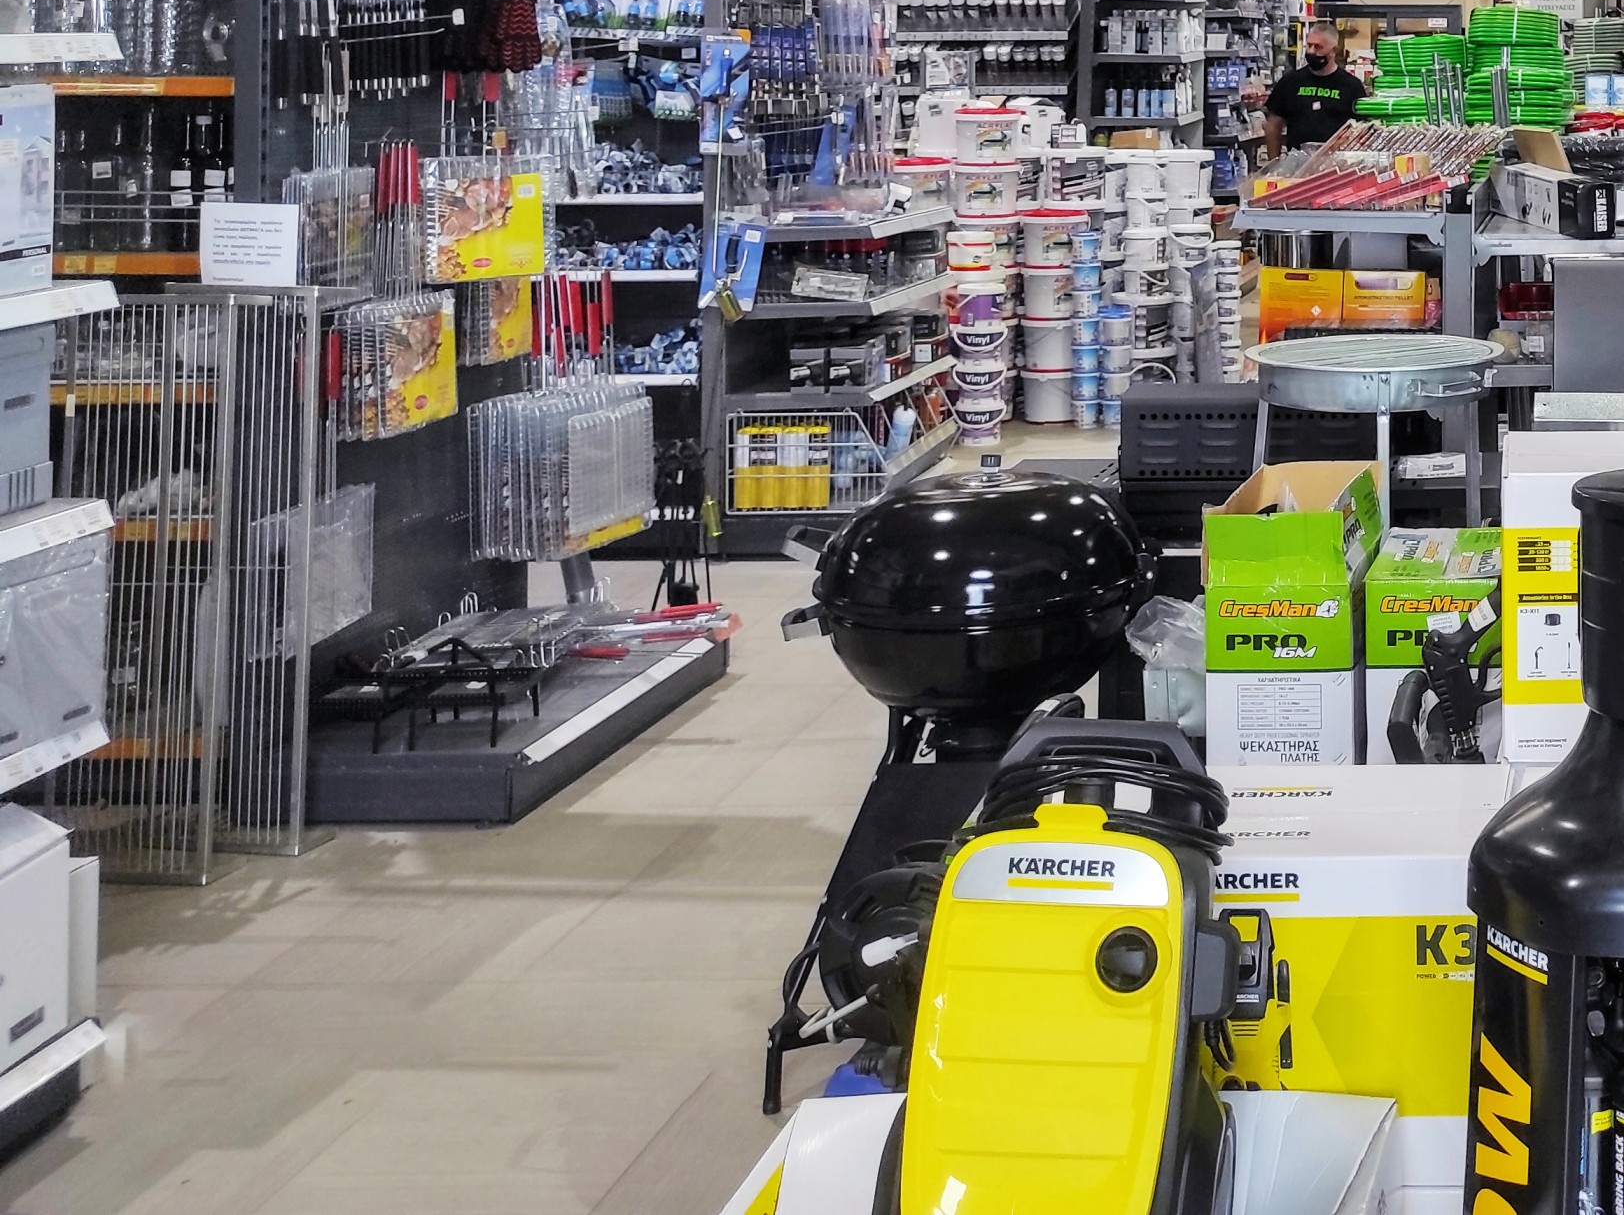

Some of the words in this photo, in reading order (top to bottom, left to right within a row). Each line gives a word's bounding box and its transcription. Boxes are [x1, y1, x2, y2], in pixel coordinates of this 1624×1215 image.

[1297, 86, 1317, 96] JUST
[1317, 87, 1330, 97] DO
[22, 247, 48, 257] PERSONAL
[966, 335, 990, 345] Vinyl
[965, 374, 989, 383] Vinyl
[965, 412, 990, 423] Vinyl
[1219, 600, 1317, 617] CresMan
[1381, 595, 1480, 613] CresMan
[1226, 634, 1307, 651] PRO
[1273, 646, 1318, 658] 16M
[1239, 740, 1320, 752] ΨΕΚΑΣΤΗΡΑΣ
[1280, 752, 1320, 763] ΠΛΑΤΗΣ
[1007, 855, 1116, 879] KÄRCHER
[1214, 872, 1300, 889] ÄRCHER
[1416, 924, 1477, 966] K3
[1486, 924, 1549, 971] KÄRCHER
[1615, 1133, 1624, 1173] BACK
[1615, 1173, 1624, 1215] BRING
